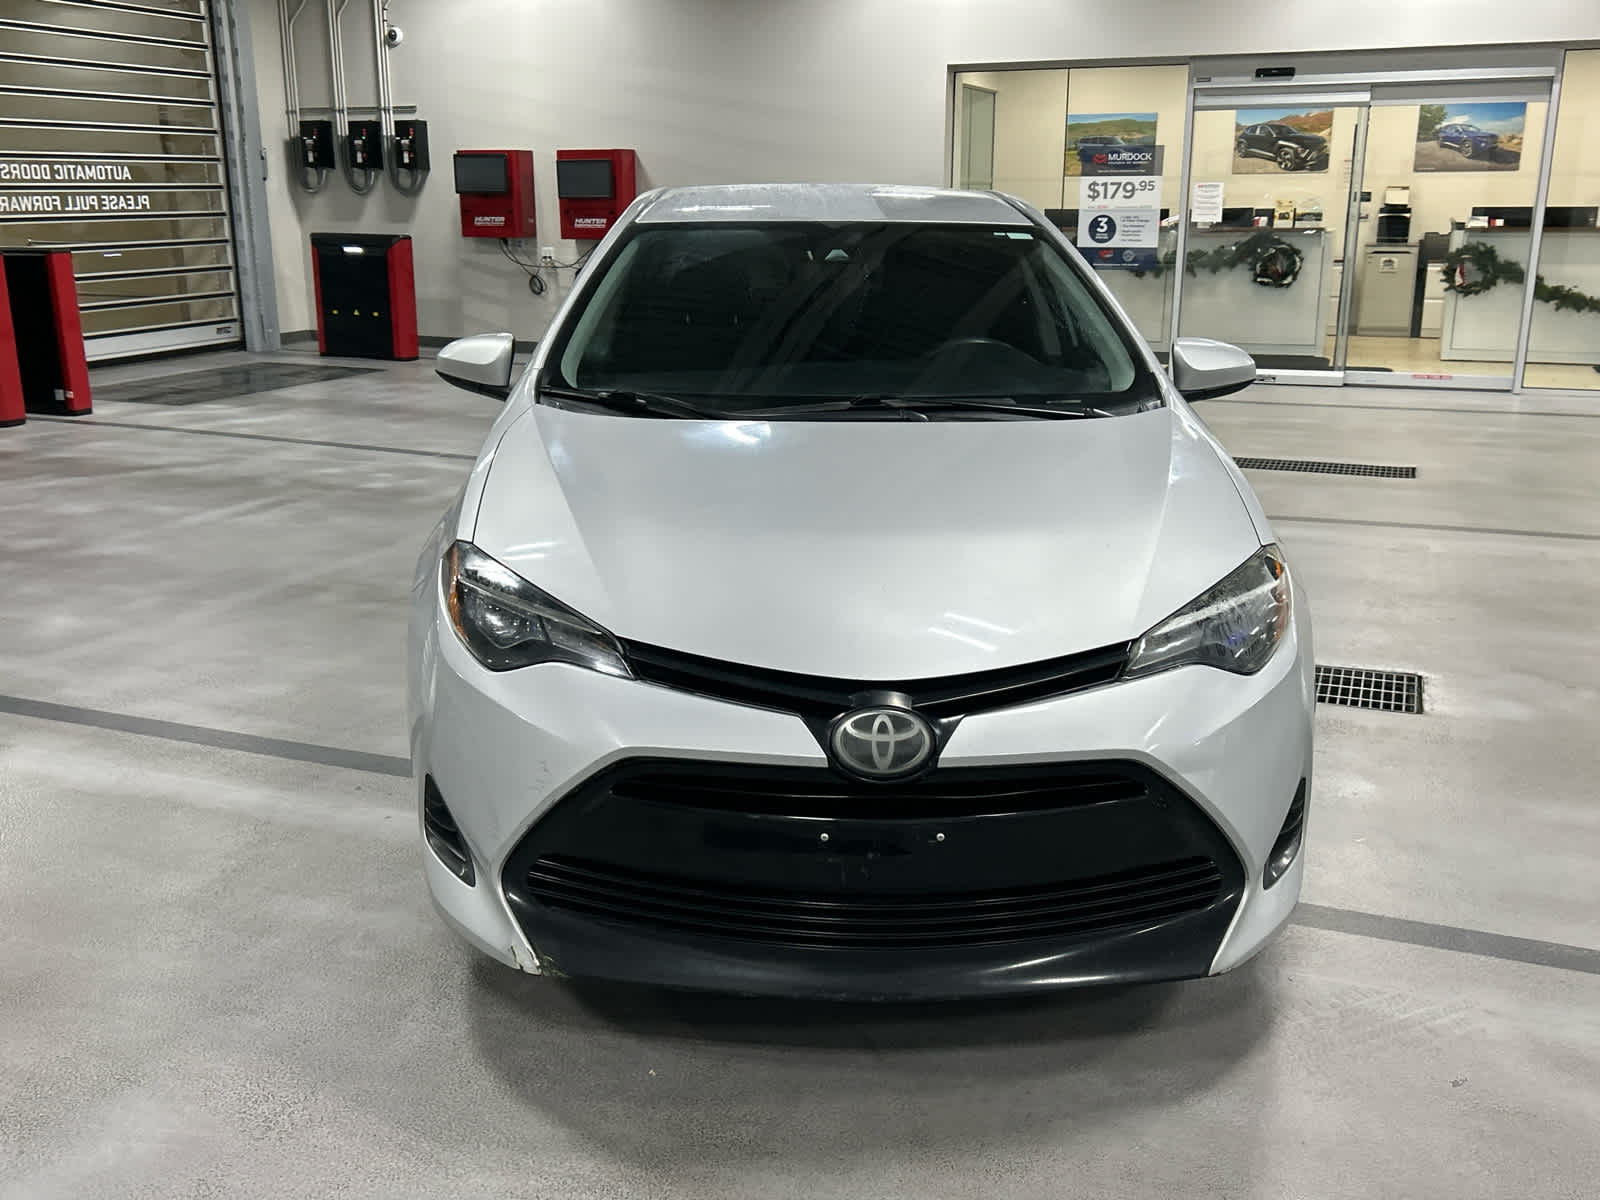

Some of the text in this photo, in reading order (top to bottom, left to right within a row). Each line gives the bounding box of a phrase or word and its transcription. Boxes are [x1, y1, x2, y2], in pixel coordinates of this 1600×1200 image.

[1108, 152, 1152, 161] MURDOCK
[1087, 180, 1156, 202] $179.95
[1096, 217, 1109, 233] 3
